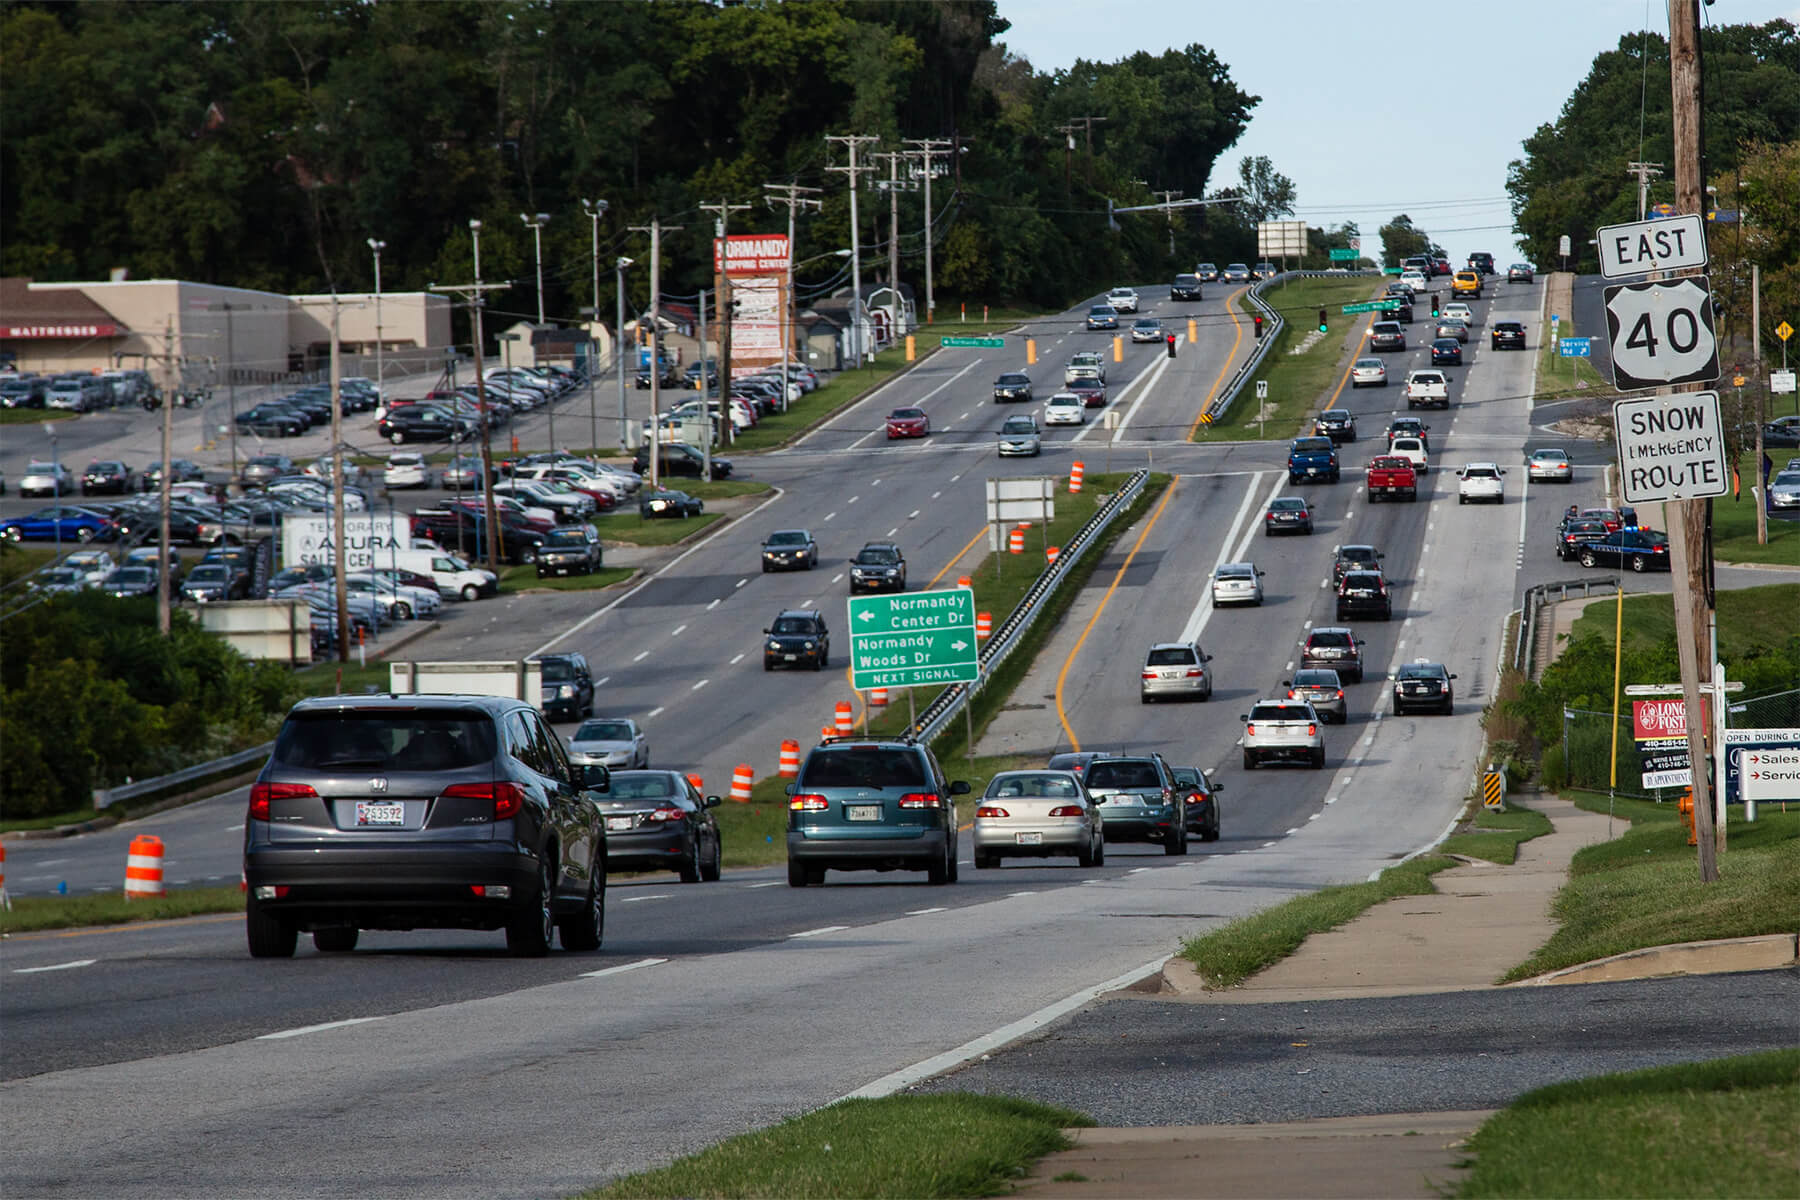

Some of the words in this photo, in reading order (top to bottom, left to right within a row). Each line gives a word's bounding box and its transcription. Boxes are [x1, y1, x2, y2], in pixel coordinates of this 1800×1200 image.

[716, 239, 788, 258] NORMANDY
[1615, 228, 1686, 265] EAST
[10, 326, 97, 337] MATTRESSES
[1625, 308, 1699, 357] 40
[1631, 406, 1704, 435] SNOW
[1631, 460, 1718, 491] ROUTE
[310, 521, 394, 533] TEMORARY
[300, 554, 338, 567] SALE
[890, 595, 965, 611] Normandy
[891, 616, 940, 628] Center
[948, 612, 965, 624] Dr
[858, 635, 934, 650] Normandy
[860, 654, 907, 668] Woods
[914, 652, 931, 664] Dr
[873, 673, 905, 683] NEXT
[913, 669, 959, 681] SIGNAL
[1658, 702, 1686, 716] LONG
[1658, 716, 1687, 730] FOST
[1726, 734, 1751, 742] OPEN
[1755, 733, 1788, 741] DURING
[1761, 755, 1799, 764] Sales
